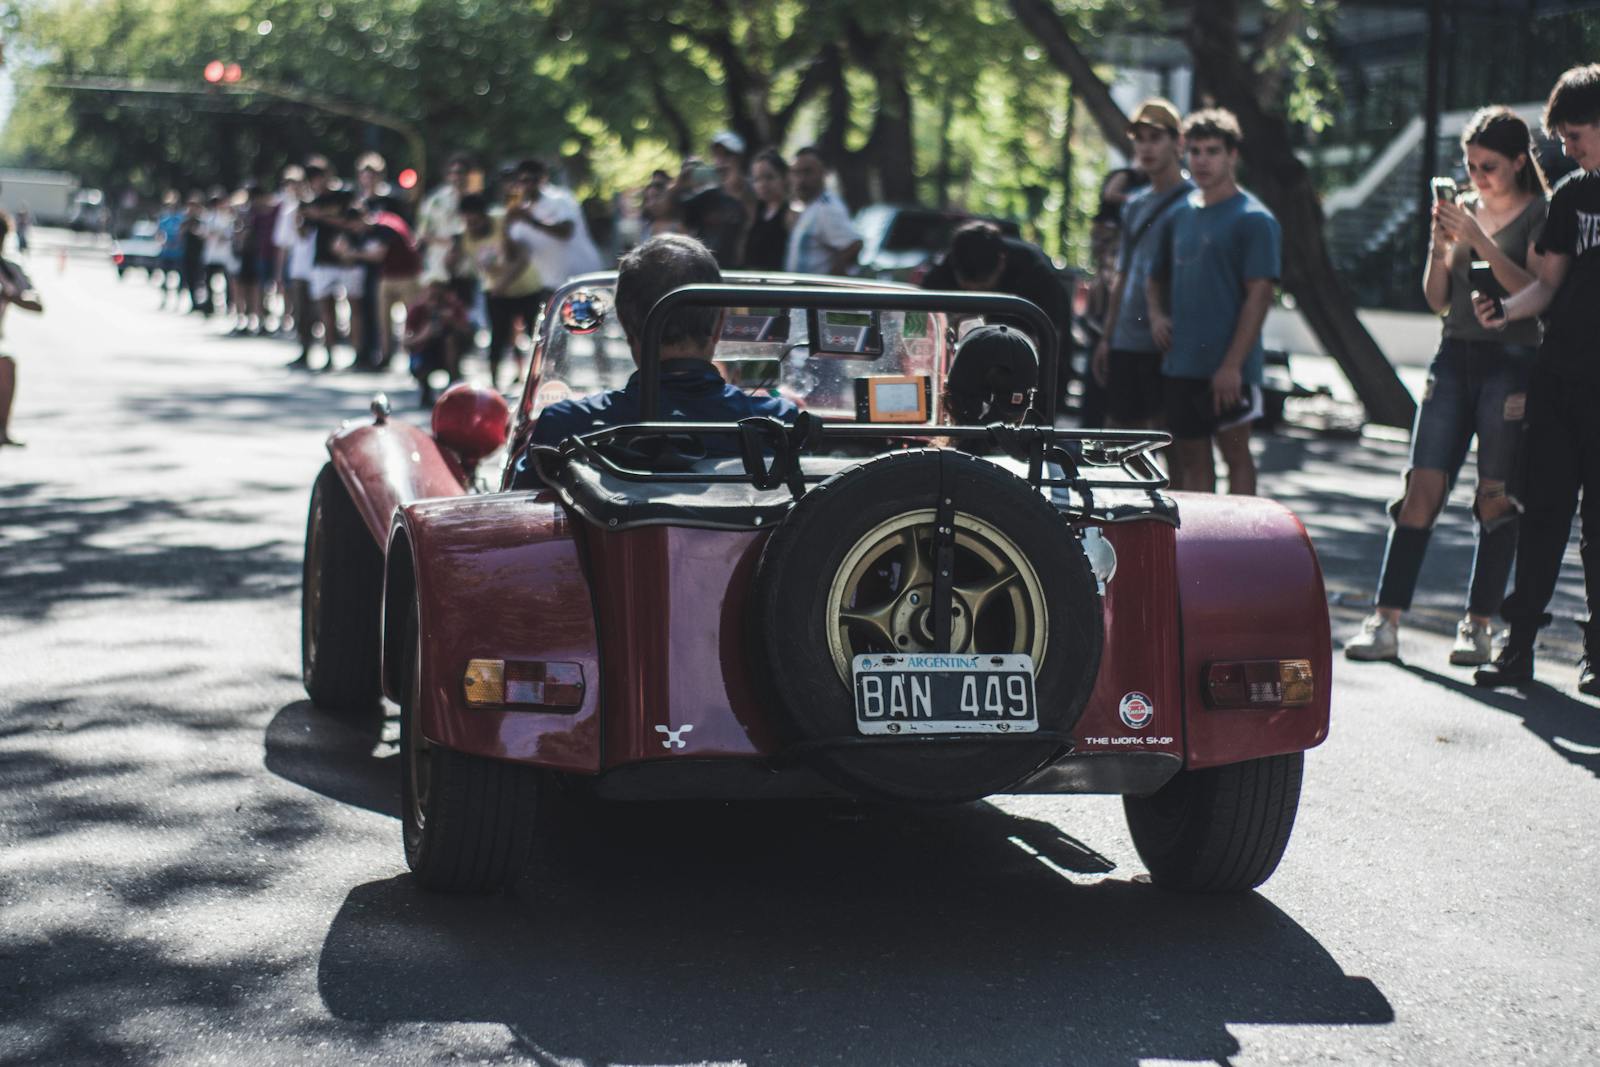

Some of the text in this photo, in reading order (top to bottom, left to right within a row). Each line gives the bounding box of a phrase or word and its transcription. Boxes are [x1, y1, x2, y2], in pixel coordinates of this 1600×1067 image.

[907, 656, 979, 668] ARGENTINA
[862, 675, 1028, 718] BAN 449
[1084, 736, 1174, 745] THE WORK SHOP
